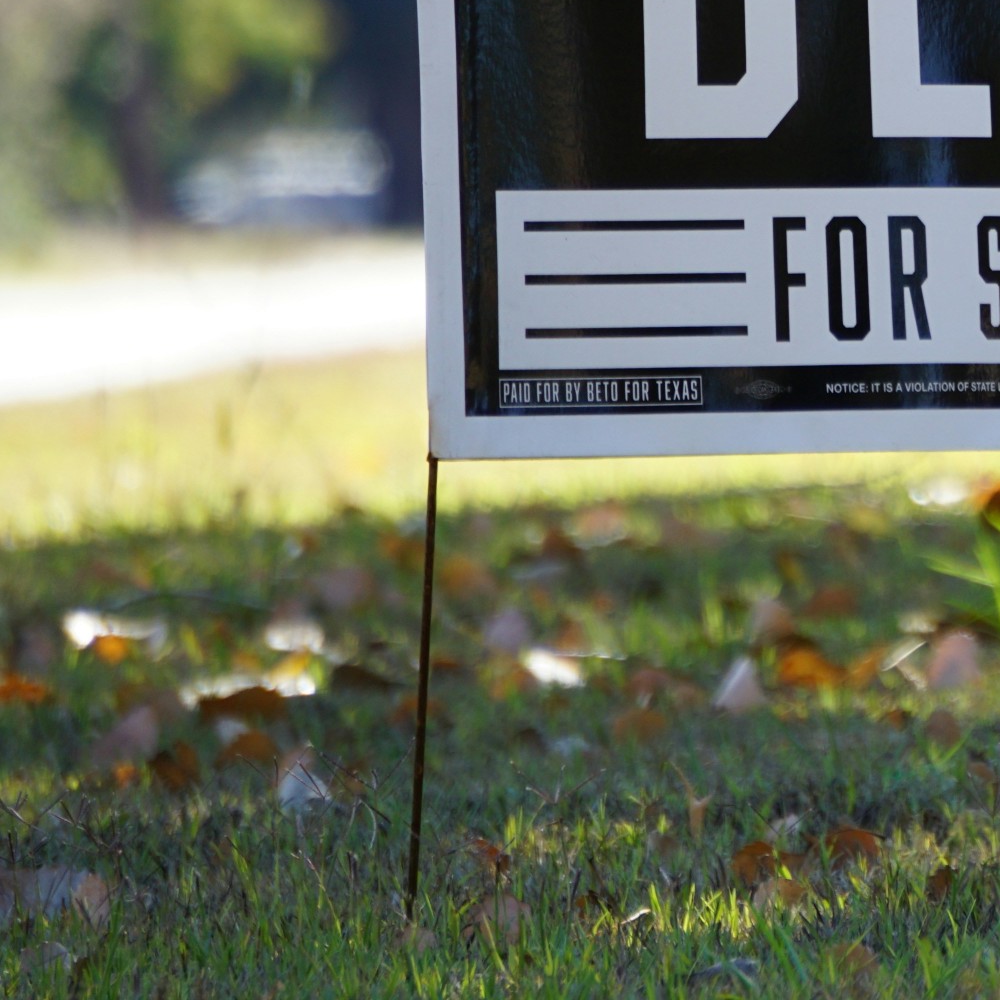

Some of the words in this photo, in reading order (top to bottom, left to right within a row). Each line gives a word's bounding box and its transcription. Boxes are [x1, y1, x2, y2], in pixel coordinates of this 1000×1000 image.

[773, 216, 931, 342] FOR
[503, 382, 531, 403] PAID
[536, 382, 560, 403] FOR
[566, 382, 581, 402] BY
[587, 381, 618, 402] BETO
[624, 381, 649, 401] FOR
[656, 380, 698, 401] TEXAS
[871, 382, 881, 393] IT
[883, 382, 893, 393] IS
[895, 382, 903, 393] A
[905, 382, 956, 393] VIOLATION
[957, 382, 969, 392] OF
[970, 382, 996, 392] STATE
